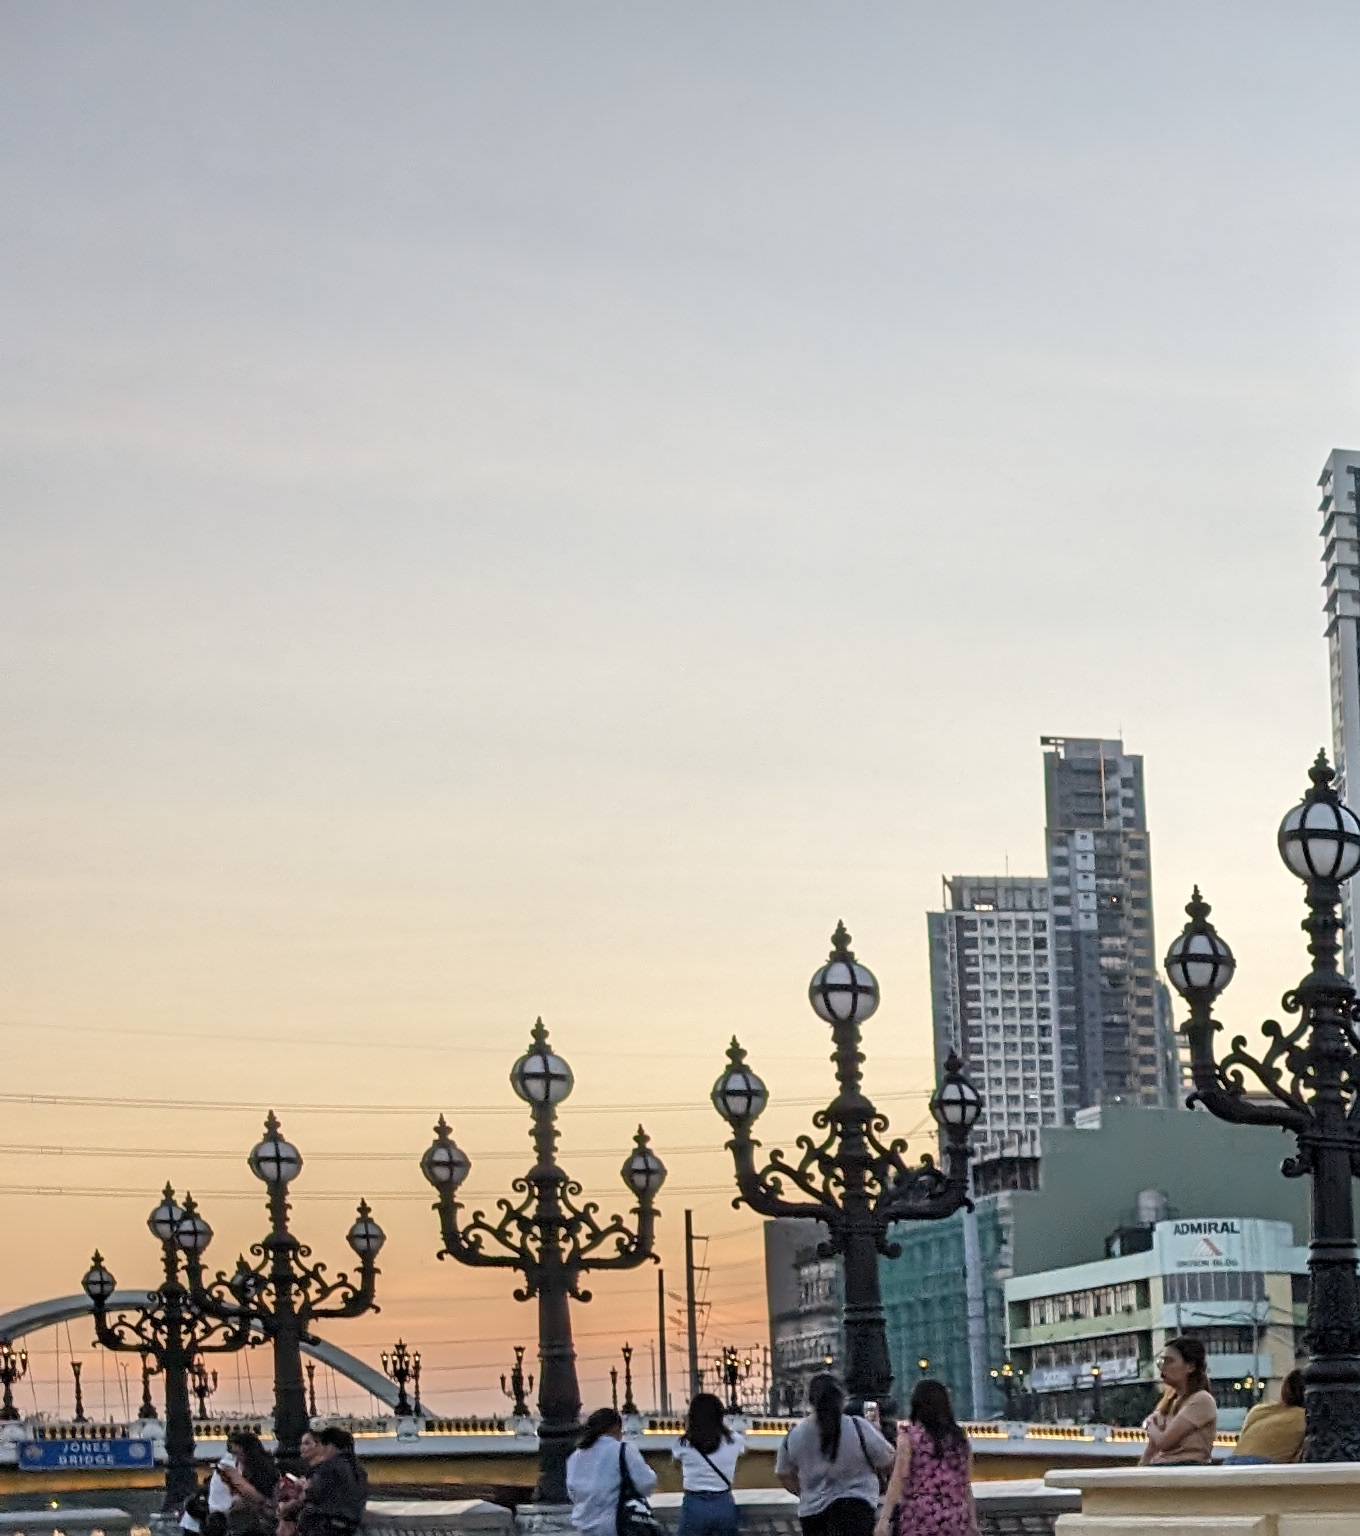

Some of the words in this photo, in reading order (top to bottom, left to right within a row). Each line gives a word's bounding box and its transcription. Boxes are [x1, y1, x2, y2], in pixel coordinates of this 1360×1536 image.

[1173, 1221, 1241, 1236] ADMIRAL
[62, 1442, 111, 1453] JONES
[57, 1455, 114, 1466] BRIDGE
